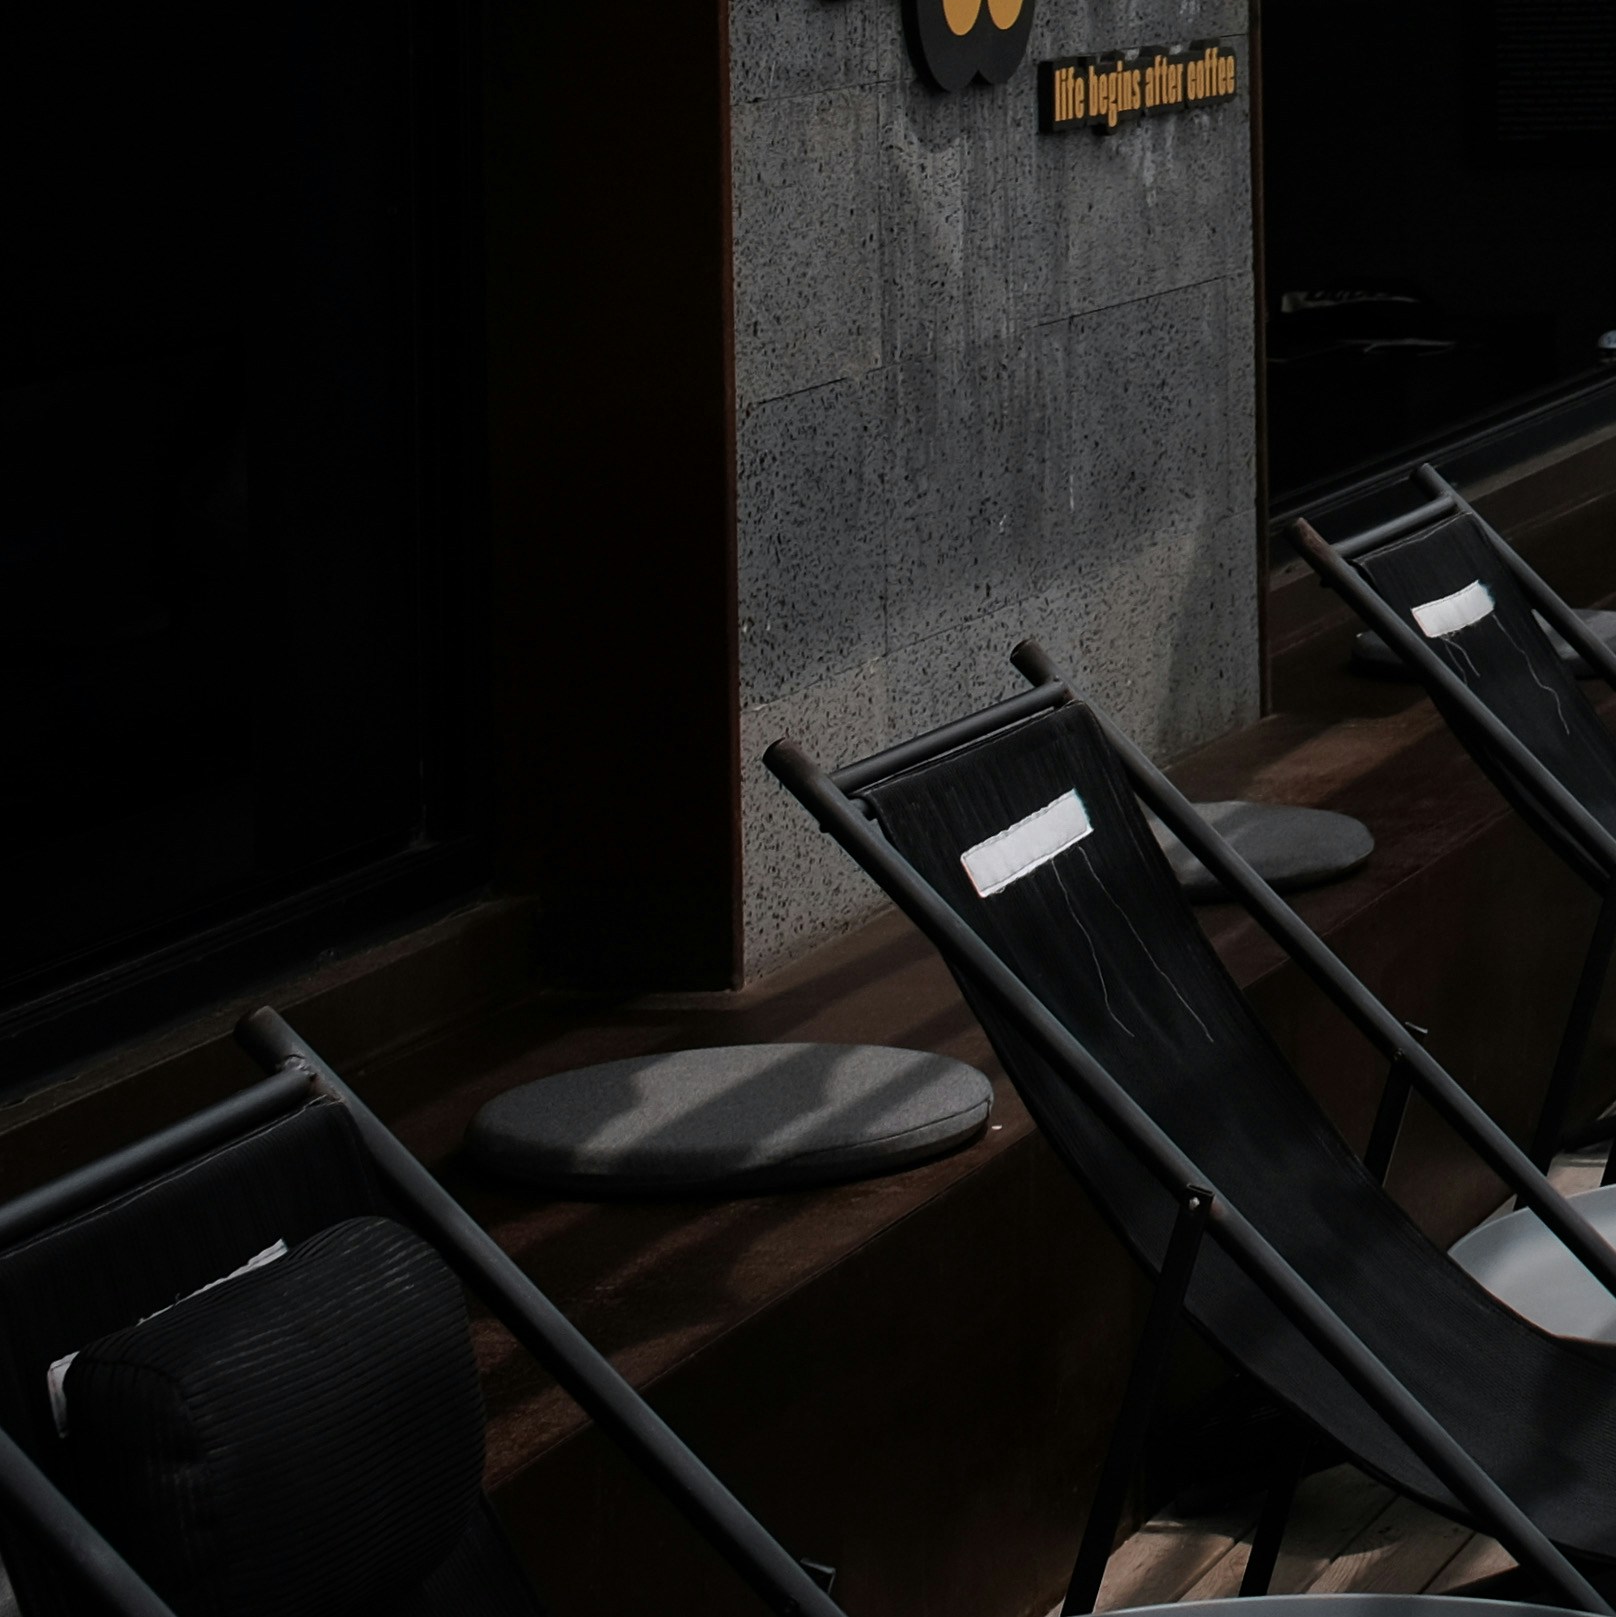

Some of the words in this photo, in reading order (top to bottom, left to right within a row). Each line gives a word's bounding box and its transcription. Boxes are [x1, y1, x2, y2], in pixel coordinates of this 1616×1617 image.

[1055, 66, 1085, 122] life
[1089, 60, 1140, 127] begins
[1145, 54, 1183, 108] after
[1187, 47, 1235, 100] coffee
